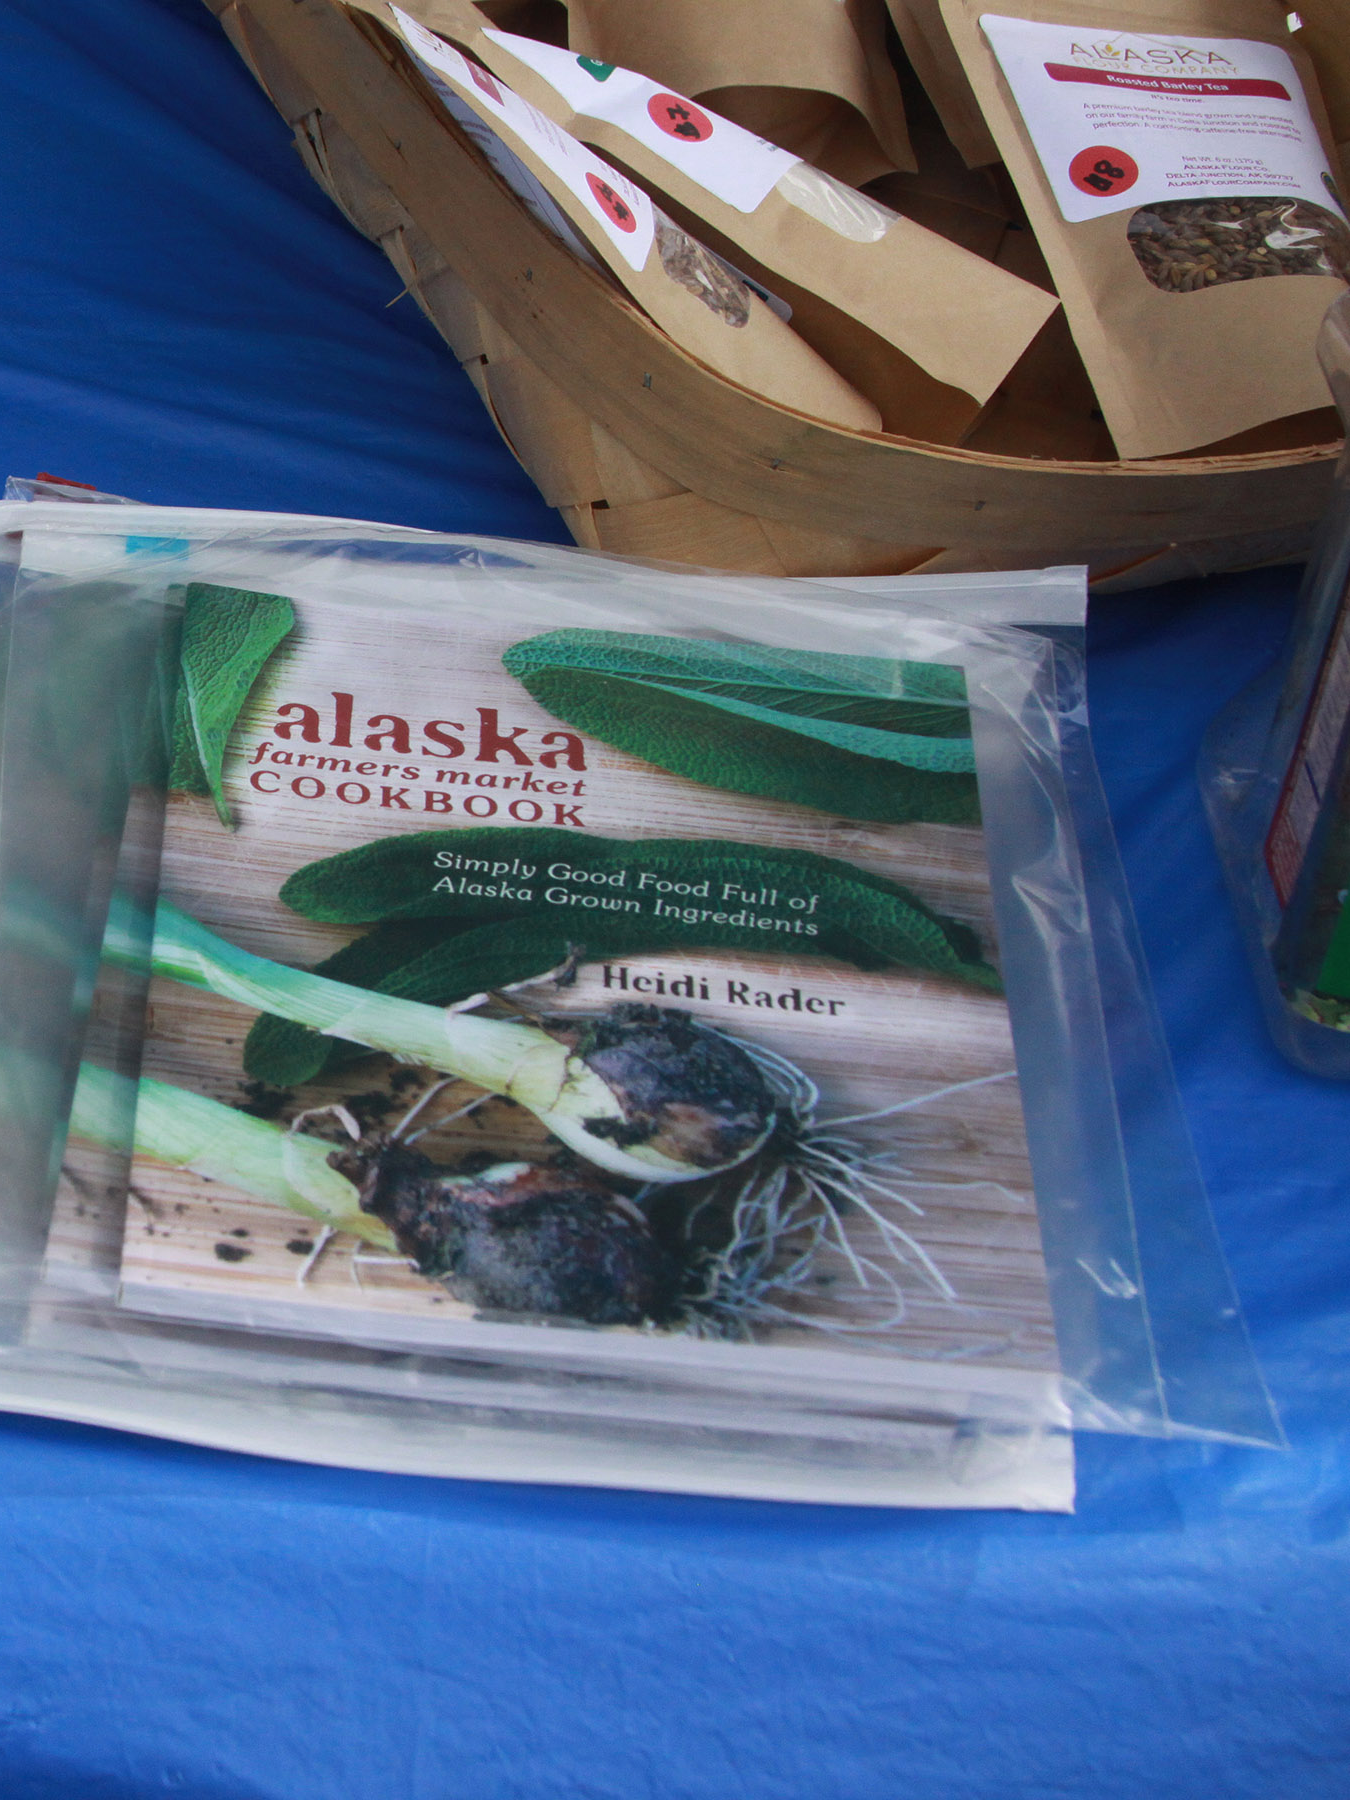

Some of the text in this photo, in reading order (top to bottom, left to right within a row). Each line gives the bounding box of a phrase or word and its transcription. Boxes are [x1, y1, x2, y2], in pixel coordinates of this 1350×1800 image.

[1070, 42, 1233, 65] ALASKA
[1140, 63, 1240, 76] COMPANY
[1106, 75, 1229, 92] Roasted Barley Tea
[273, 691, 588, 771] alaska
[248, 742, 588, 798] farmers market
[249, 769, 586, 827] COOKBOOK
[431, 875, 820, 937] Alaska Grown Ingredients
[433, 851, 820, 915] Simply Good Food Full of
[602, 964, 847, 1017] Heidi Rader
